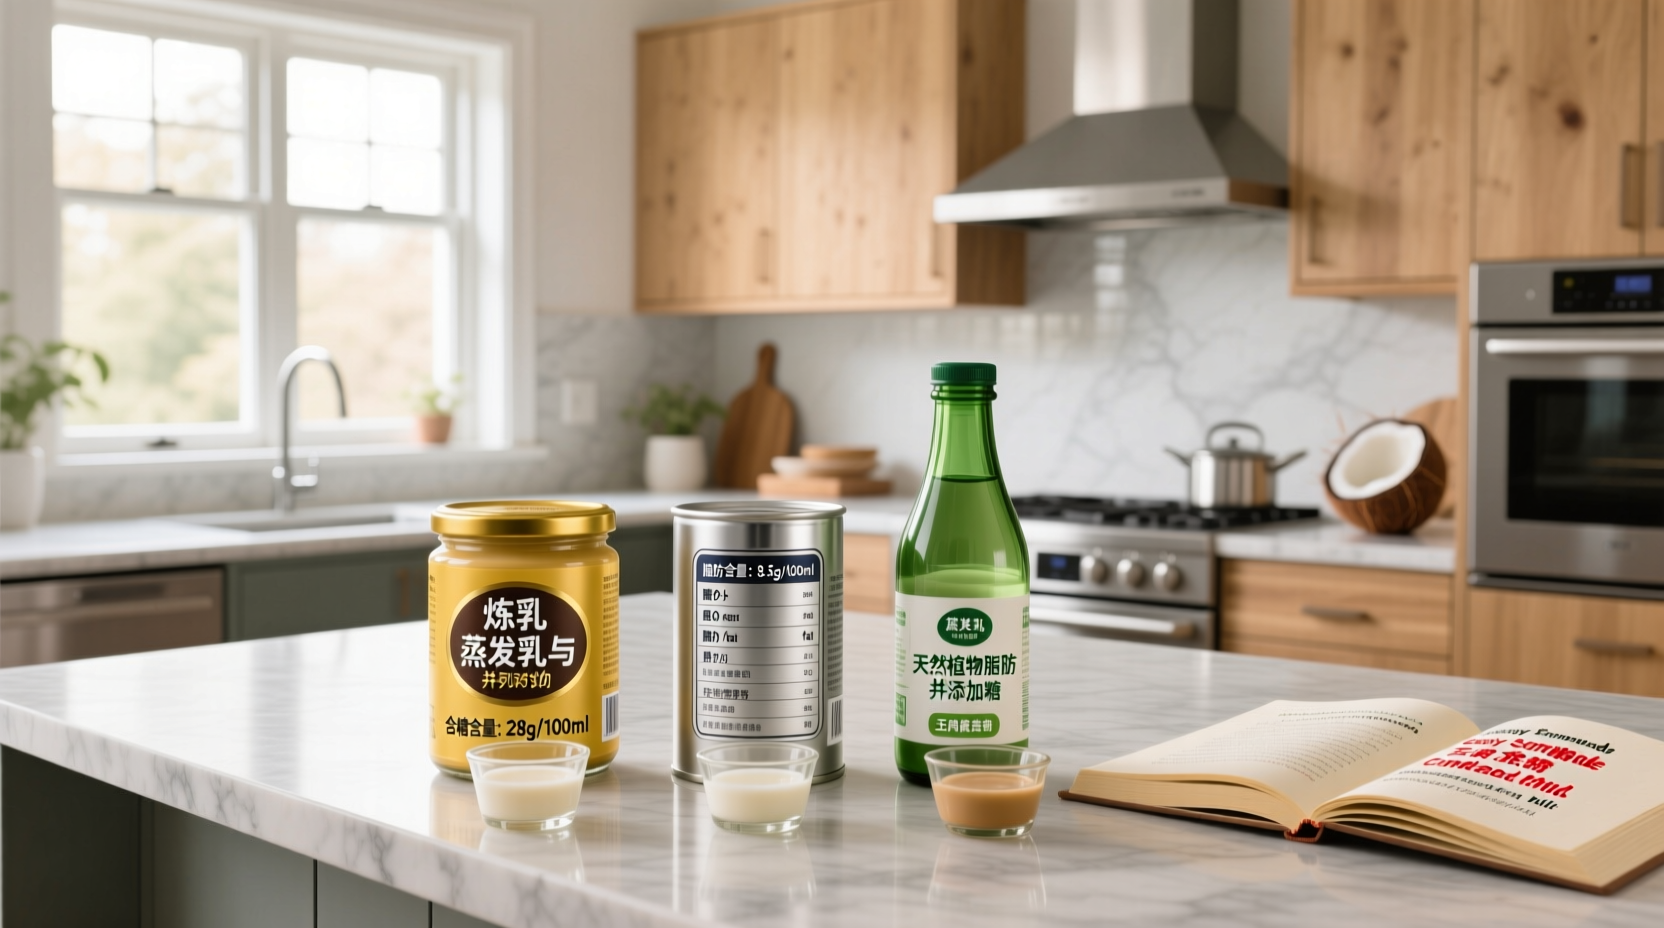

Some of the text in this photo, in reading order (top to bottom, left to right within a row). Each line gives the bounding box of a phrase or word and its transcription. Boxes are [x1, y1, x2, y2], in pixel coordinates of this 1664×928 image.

[483, 597, 548, 632] 炼乳
[460, 633, 576, 669] 蒸发乳与
[505, 714, 589, 741] 28g/100ml
